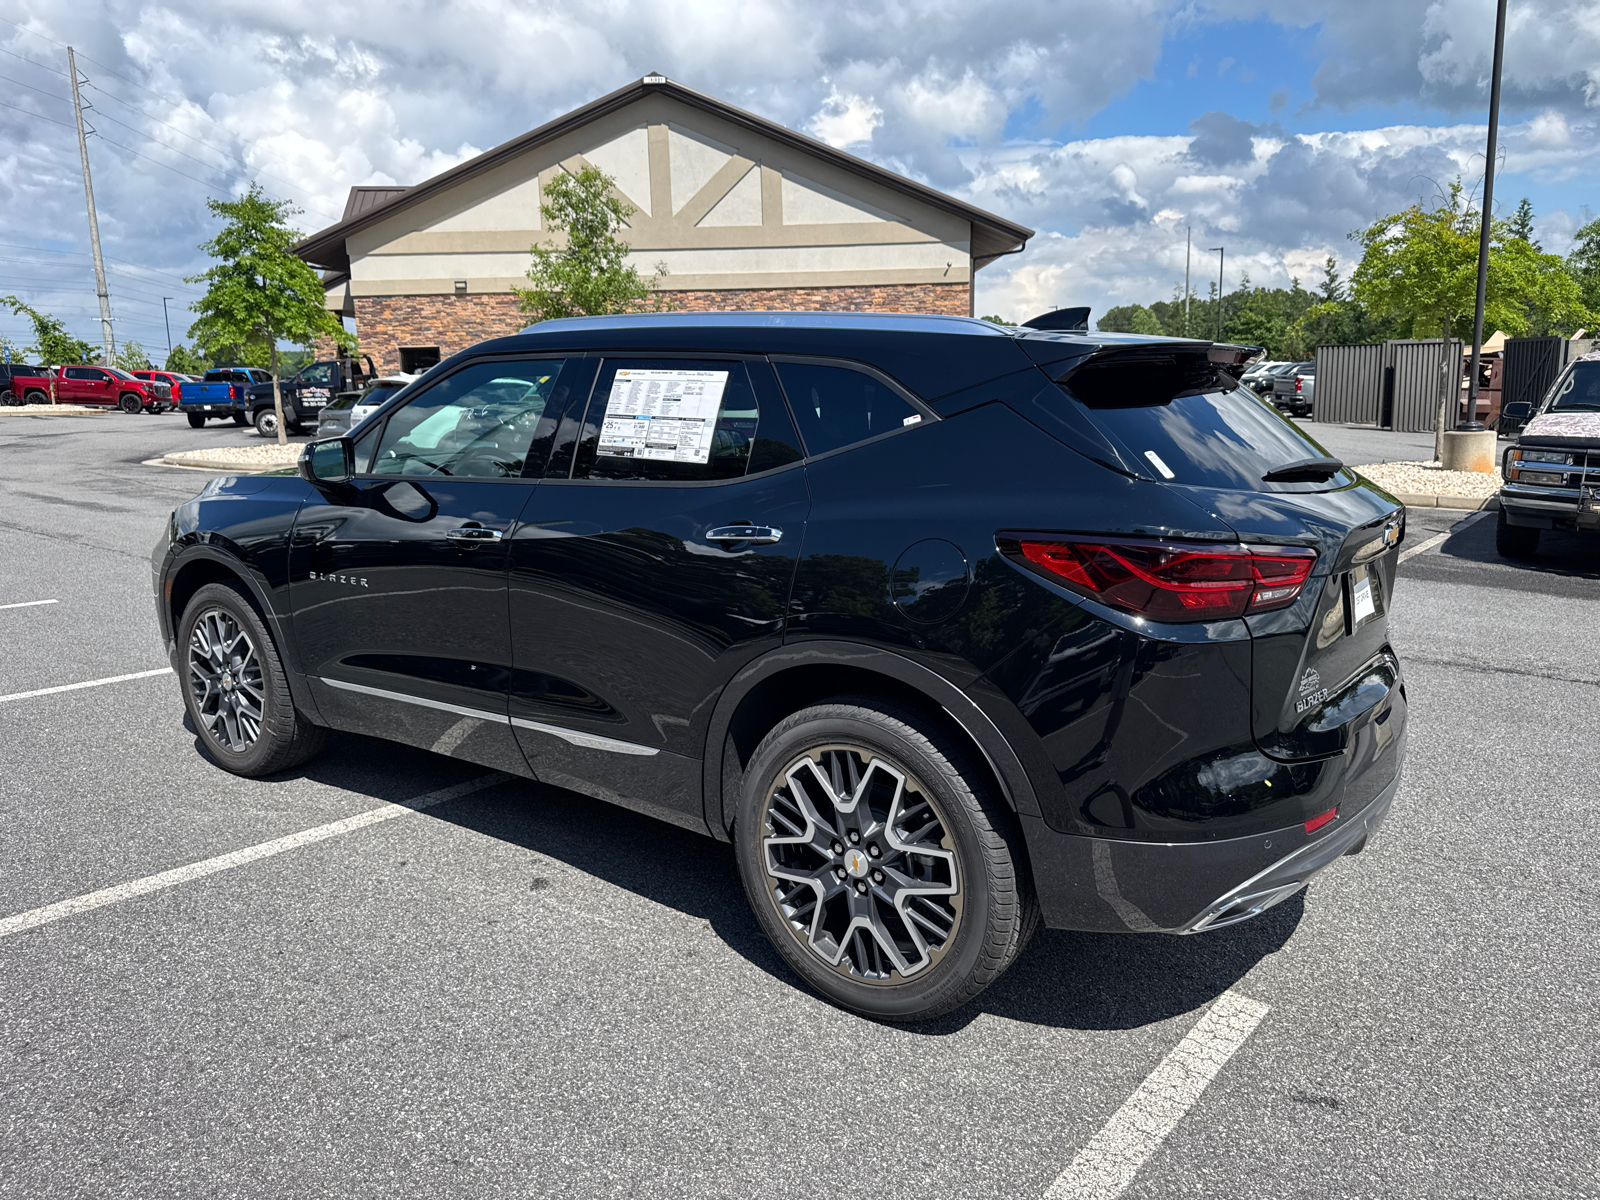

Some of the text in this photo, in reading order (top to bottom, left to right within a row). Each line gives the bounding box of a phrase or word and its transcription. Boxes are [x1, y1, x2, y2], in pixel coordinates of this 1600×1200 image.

[605, 421, 614, 429] 25
[309, 571, 369, 588] BLAZER
[1296, 688, 1328, 713] BLAZER
